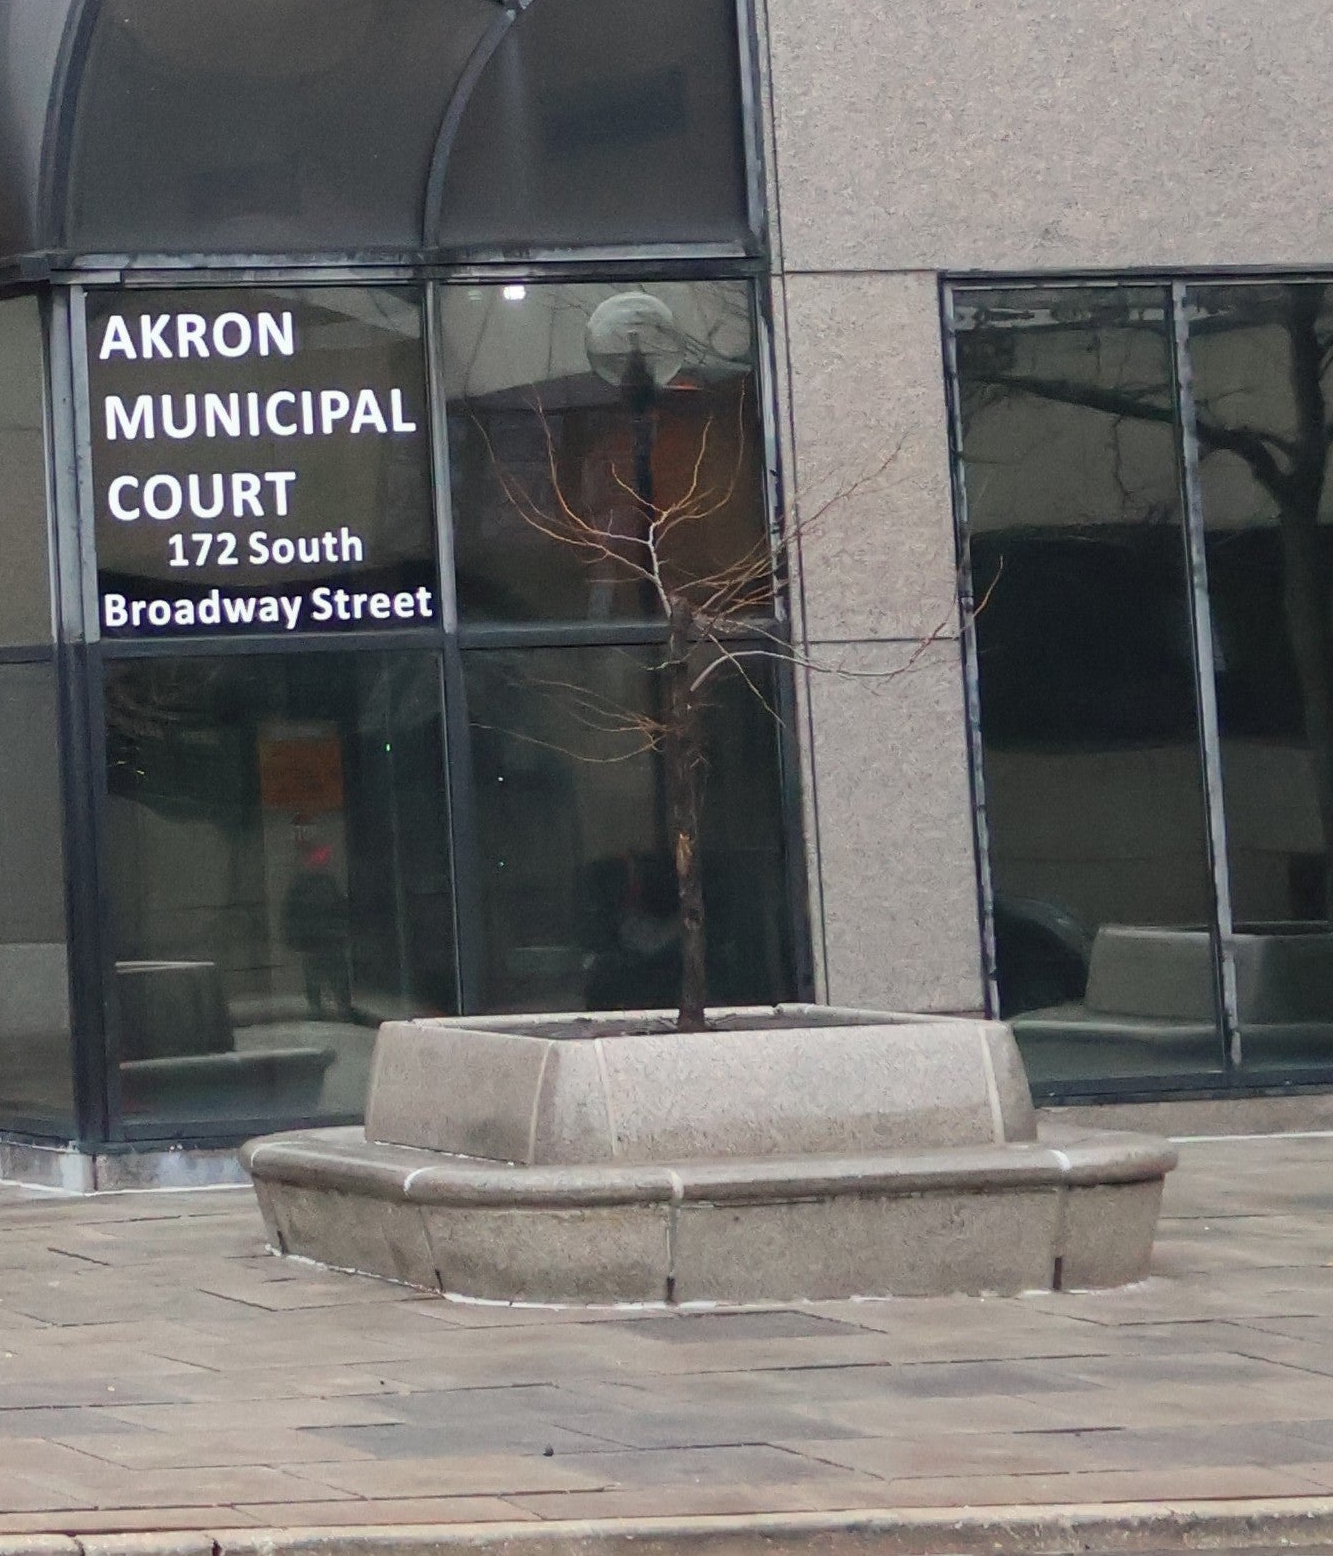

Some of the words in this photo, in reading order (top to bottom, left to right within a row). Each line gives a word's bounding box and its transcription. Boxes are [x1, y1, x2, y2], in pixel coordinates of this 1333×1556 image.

[100, 312, 293, 359] AKRON
[105, 389, 416, 440] MUNICIPAL
[109, 472, 295, 520] COURT
[169, 533, 238, 566] 172
[249, 527, 362, 564] South
[105, 590, 301, 629] Broadway
[313, 587, 432, 620] Street
